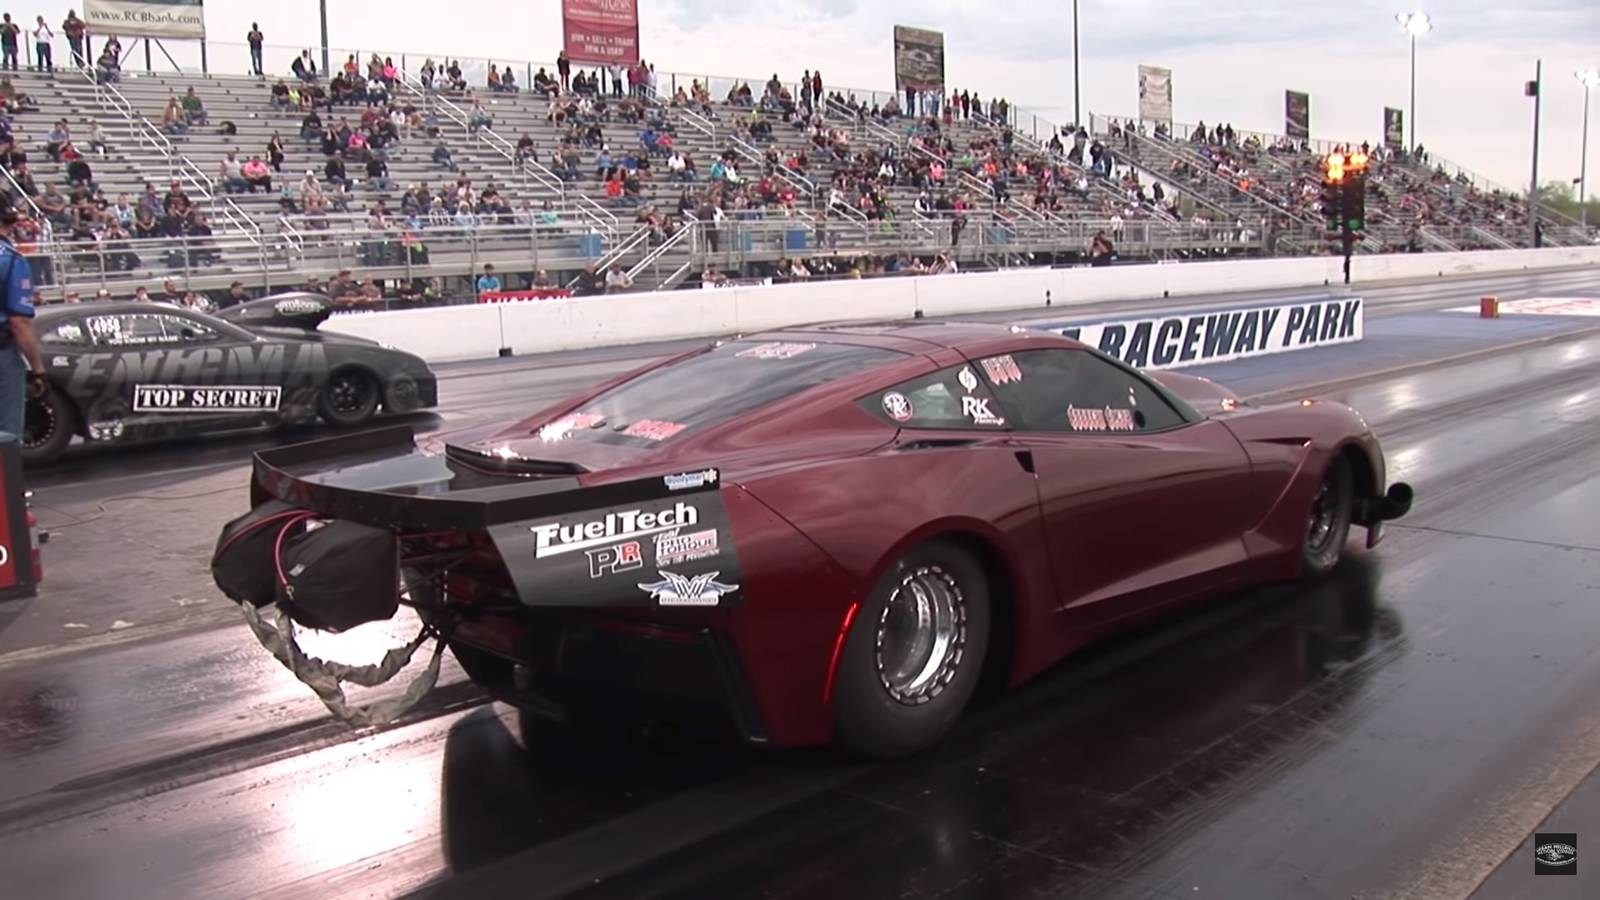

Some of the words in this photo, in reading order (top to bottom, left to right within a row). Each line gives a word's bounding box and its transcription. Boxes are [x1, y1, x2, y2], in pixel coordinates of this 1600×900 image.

[90, 11, 200, 24] www.RCBbank.com
[1098, 309, 1280, 368] RACEWAY
[1283, 300, 1360, 348] PARK
[140, 389, 185, 408] TOP
[192, 389, 277, 408] SECRET
[962, 396, 996, 419] RK
[530, 502, 698, 549] FuelTech
